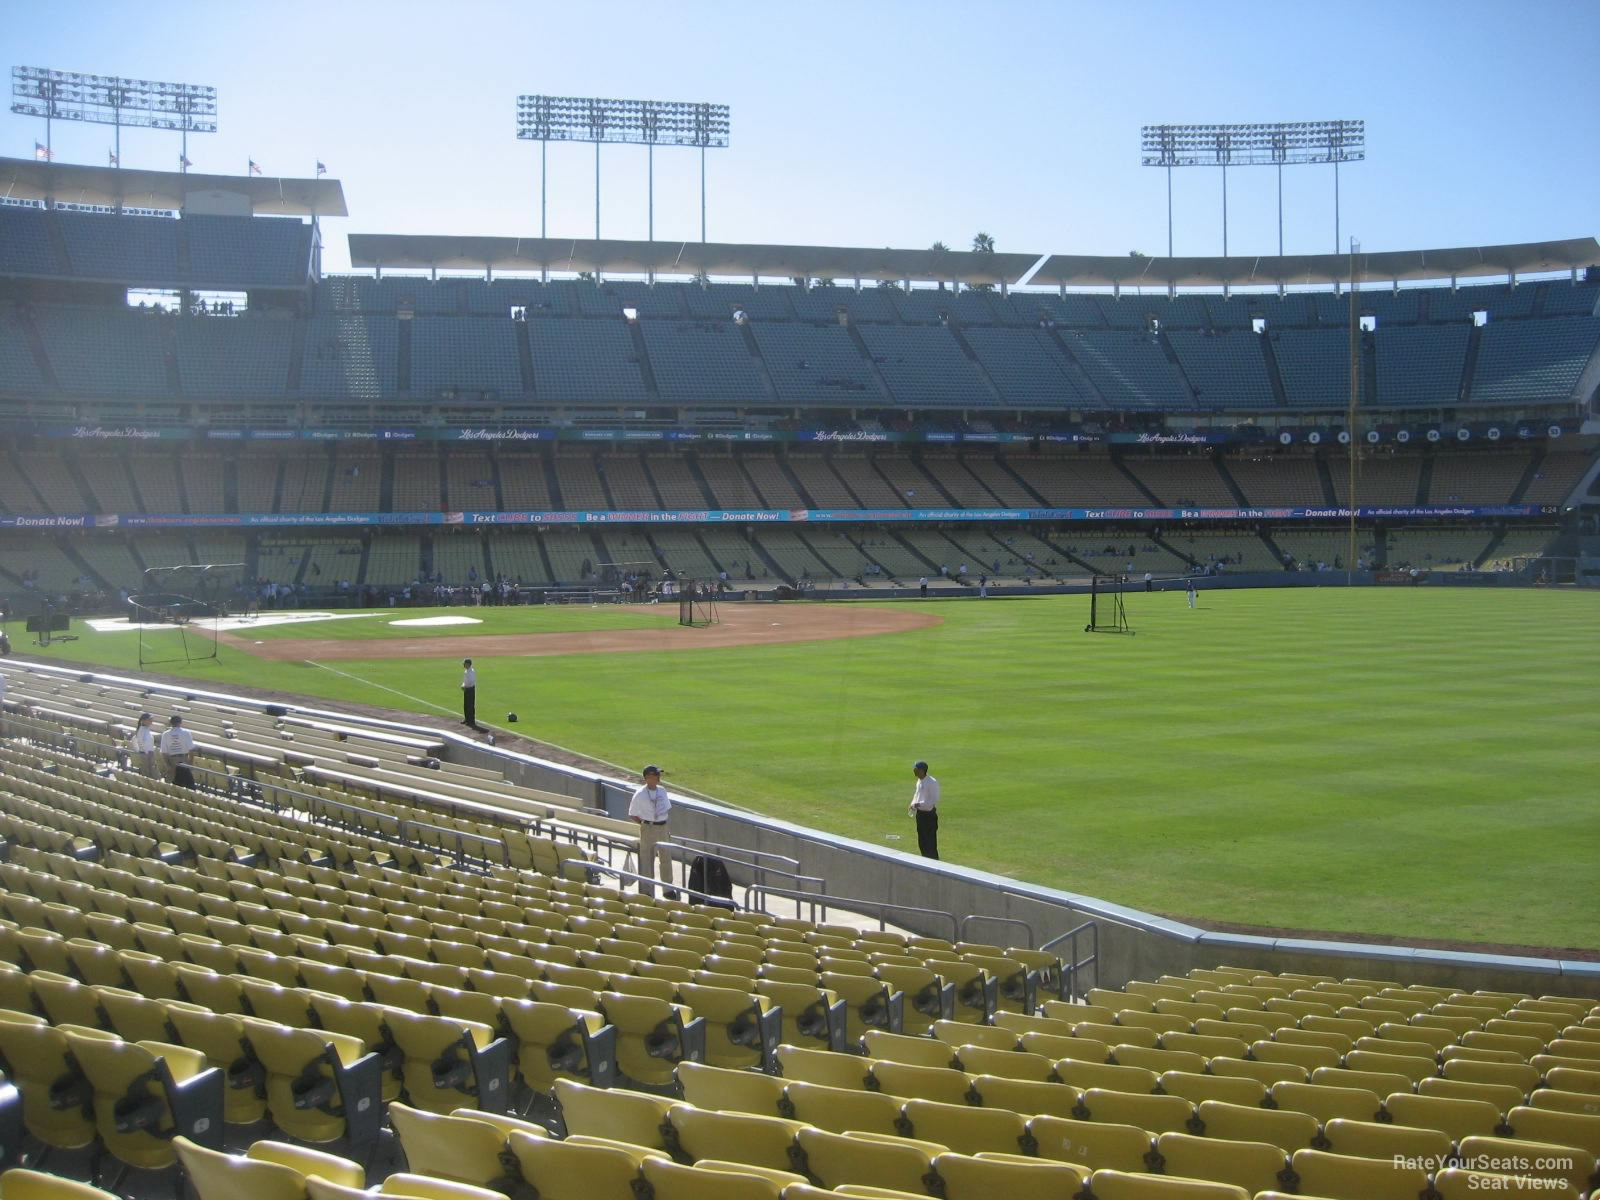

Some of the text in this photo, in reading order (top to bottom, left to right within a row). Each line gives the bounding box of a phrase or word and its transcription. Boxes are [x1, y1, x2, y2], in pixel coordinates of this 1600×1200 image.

[72, 426, 160, 439] Los Angeles Dodgers
[459, 429, 539, 440] Los Angeles Dodgers
[813, 431, 887, 442] Los Angeles Dodgers
[1136, 433, 1207, 443] Los Angeles Dodgers
[1084, 510, 1104, 518] Text
[1134, 510, 1144, 518] to
[1249, 509, 1263, 517] the
[1305, 509, 1337, 517] Donate
[1338, 508, 1360, 517] Now!
[1541, 506, 1557, 514] 4:24
[16, 516, 84, 526] Donate Now!
[472, 514, 496, 522] Text
[530, 514, 542, 522] to
[661, 512, 677, 520] the
[722, 512, 754, 521] Donate
[756, 512, 780, 520] Now!
